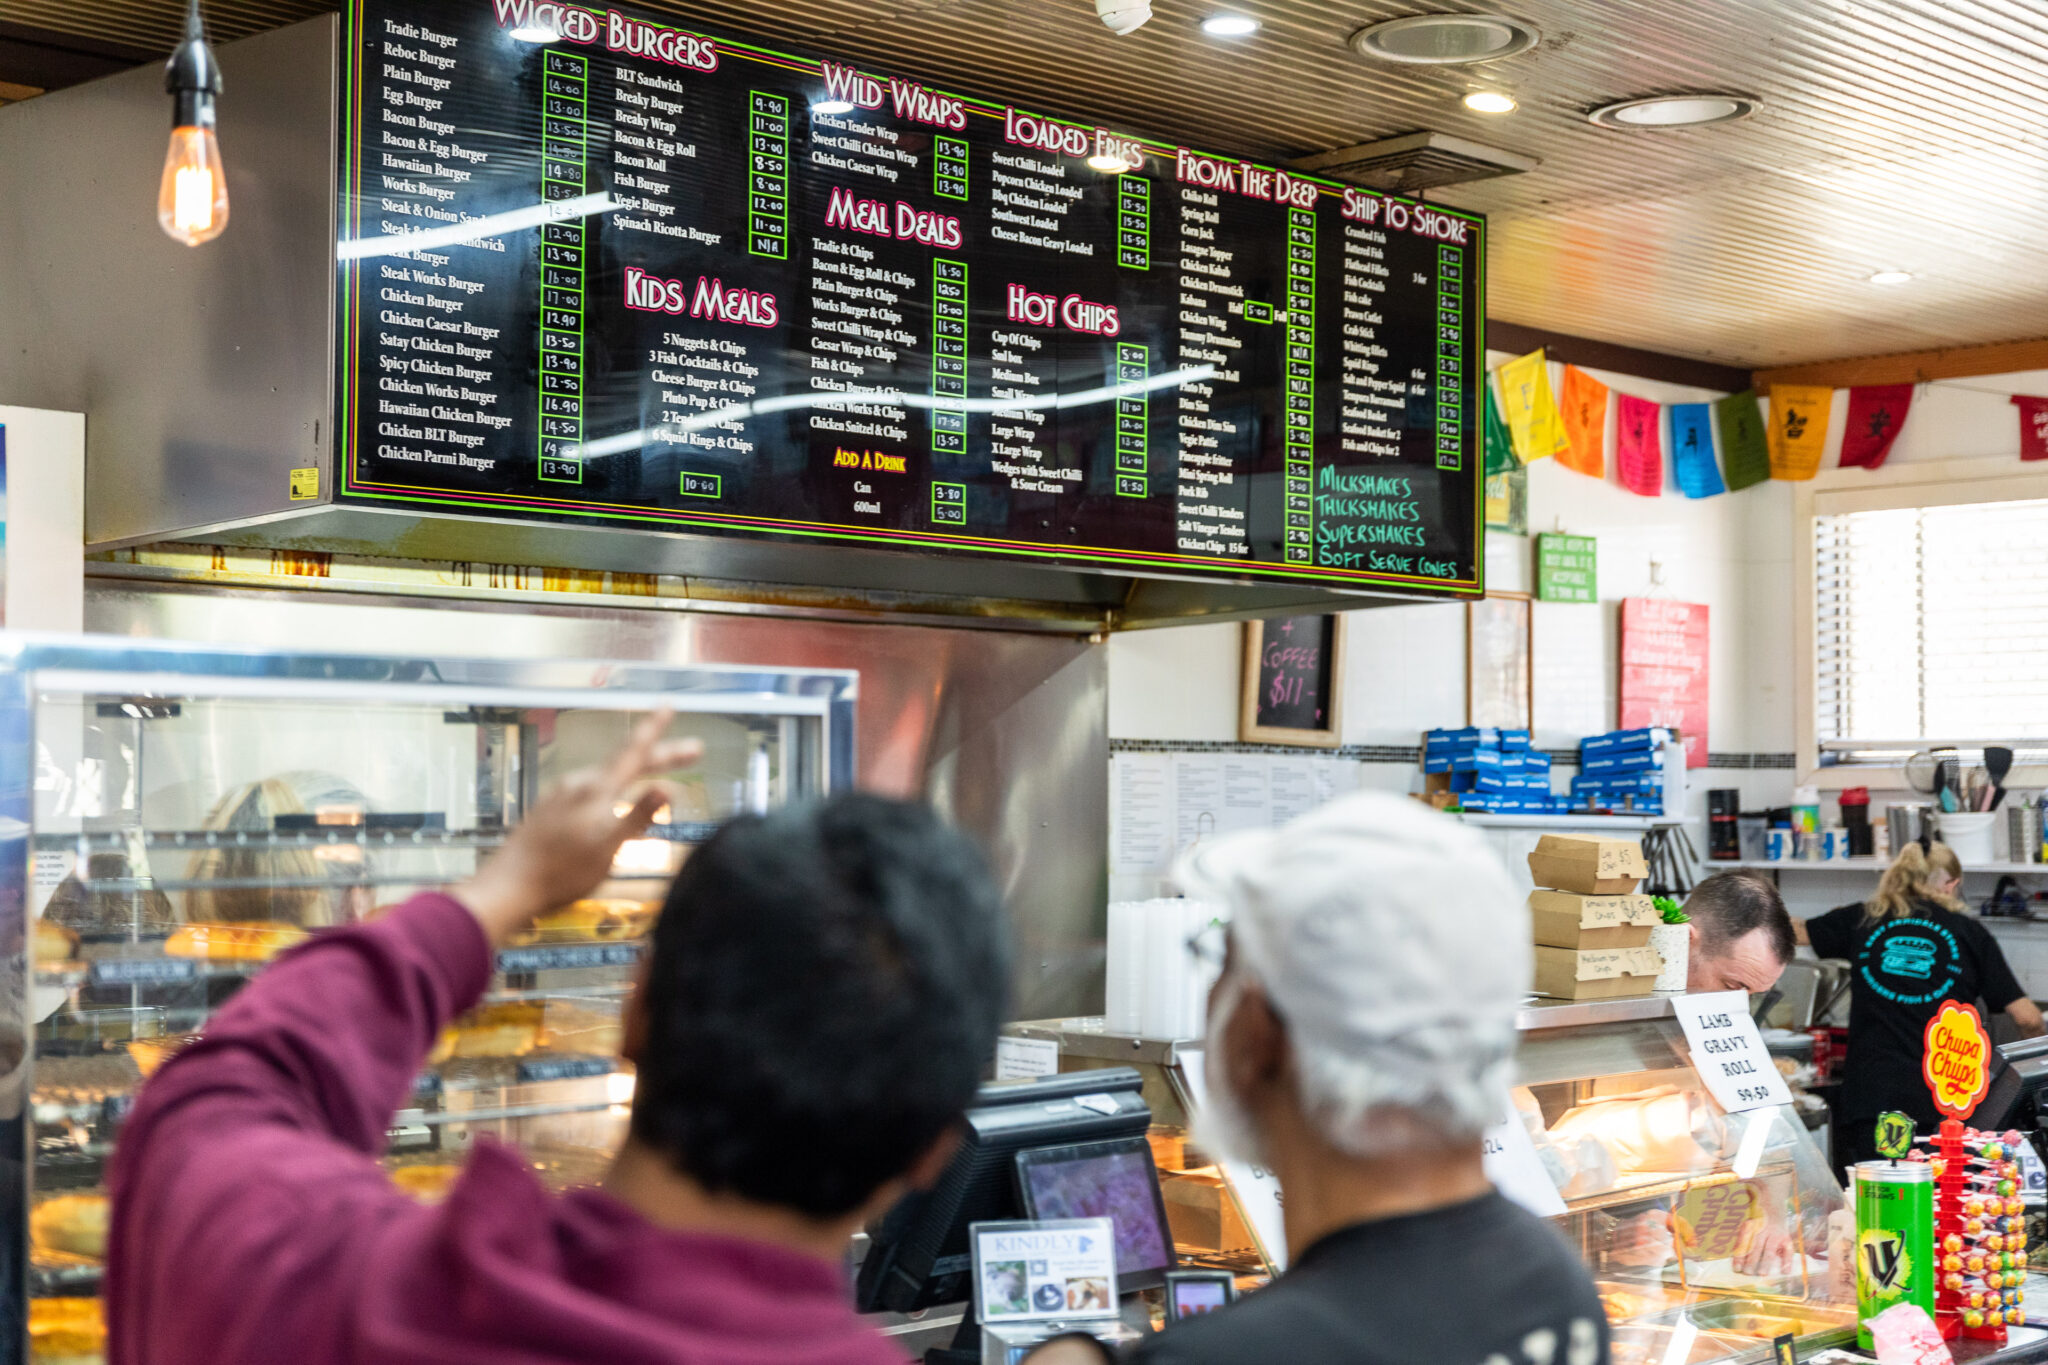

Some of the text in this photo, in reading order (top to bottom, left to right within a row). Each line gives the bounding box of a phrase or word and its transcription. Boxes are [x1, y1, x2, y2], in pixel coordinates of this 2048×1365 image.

[384, 19, 458, 48] Tradie Burger
[608, 12, 717, 70] BURGERS
[384, 42, 456, 69] Reboc Burger
[383, 65, 451, 91] Plain Burger
[616, 68, 683, 93] BLT Sandwich
[383, 87, 442, 111] Egg Burger
[616, 89, 683, 115] Breaky Burger
[822, 62, 966, 129] WILD WRAPS
[616, 110, 676, 135] Breaky Wrap
[812, 112, 898, 143] Chicken Tender Wrap
[383, 132, 487, 164] Bacon & Egg Burger
[615, 131, 696, 157] Bacon & Egg Roll
[812, 132, 918, 167] Sweet Chilli Chicken Wrap
[1006, 108, 1143, 169] LOADED FRIES
[383, 154, 471, 182] Hawaiian Burger
[812, 151, 898, 182] Chicken Caesar Wrap
[1177, 149, 1318, 208] FROM THE DEEP
[382, 176, 455, 202] Works Burger
[614, 173, 670, 195] Fish Burger
[992, 171, 1083, 199] Popcorn Chicken Loaded
[614, 193, 675, 216] Vegie Burger
[826, 189, 961, 247] MEAL DEALS
[1181, 206, 1219, 224] Spring Roll
[1343, 188, 1467, 243] SHIP TO SHORE
[613, 214, 721, 245] Spinach Ricotta Burger
[992, 227, 1093, 255] Cheese Bacon Gravy Loaded
[381, 266, 484, 294] Steak Works Burger
[626, 270, 777, 326] KIDS MEALS
[1009, 286, 1119, 335] HOT CHIPS
[380, 310, 499, 340] Chicken Caesar Burger
[380, 333, 492, 361] Satay Chicken Burger
[663, 333, 746, 357] 5 Nuggets & Chips
[380, 355, 492, 382] Spicy Chicken Burger
[649, 350, 759, 378] 3 Fish Cocktails & Chips
[811, 357, 864, 377] Fish & Chips
[379, 378, 497, 405] Chicken Works Burger
[652, 370, 755, 397] Cheese Burger & Chips
[379, 400, 512, 429] Hawaiian Chicken Burger
[1179, 398, 1209, 412] Dim Sim
[379, 423, 485, 447] Chicken BLT Burger
[810, 416, 907, 442] Chicken Snitzel & Chips
[992, 424, 1035, 442] Large Wrap
[378, 445, 495, 471] Chicken Parmi Burger
[834, 448, 906, 472] ADD A DRINK
[854, 481, 871, 493] Can
[1320, 464, 1411, 498] MILKSHAKES
[854, 502, 880, 513] 600ml
[1316, 495, 1419, 522] THICKSHAKES
[1316, 521, 1425, 548] SUPERSHAKES
[1319, 544, 1457, 579] SOFT SERVE CONES
[1699, 1014, 1732, 1029] LAMB
[1704, 1036, 1748, 1053] GRAVY
[1936, 1027, 1980, 1063] Chupa
[1721, 1060, 1757, 1076] ROLL
[1932, 1052, 1977, 1086] Chups
[995, 1235, 1075, 1253] KINDLY
[1864, 1239, 1898, 1289] V
